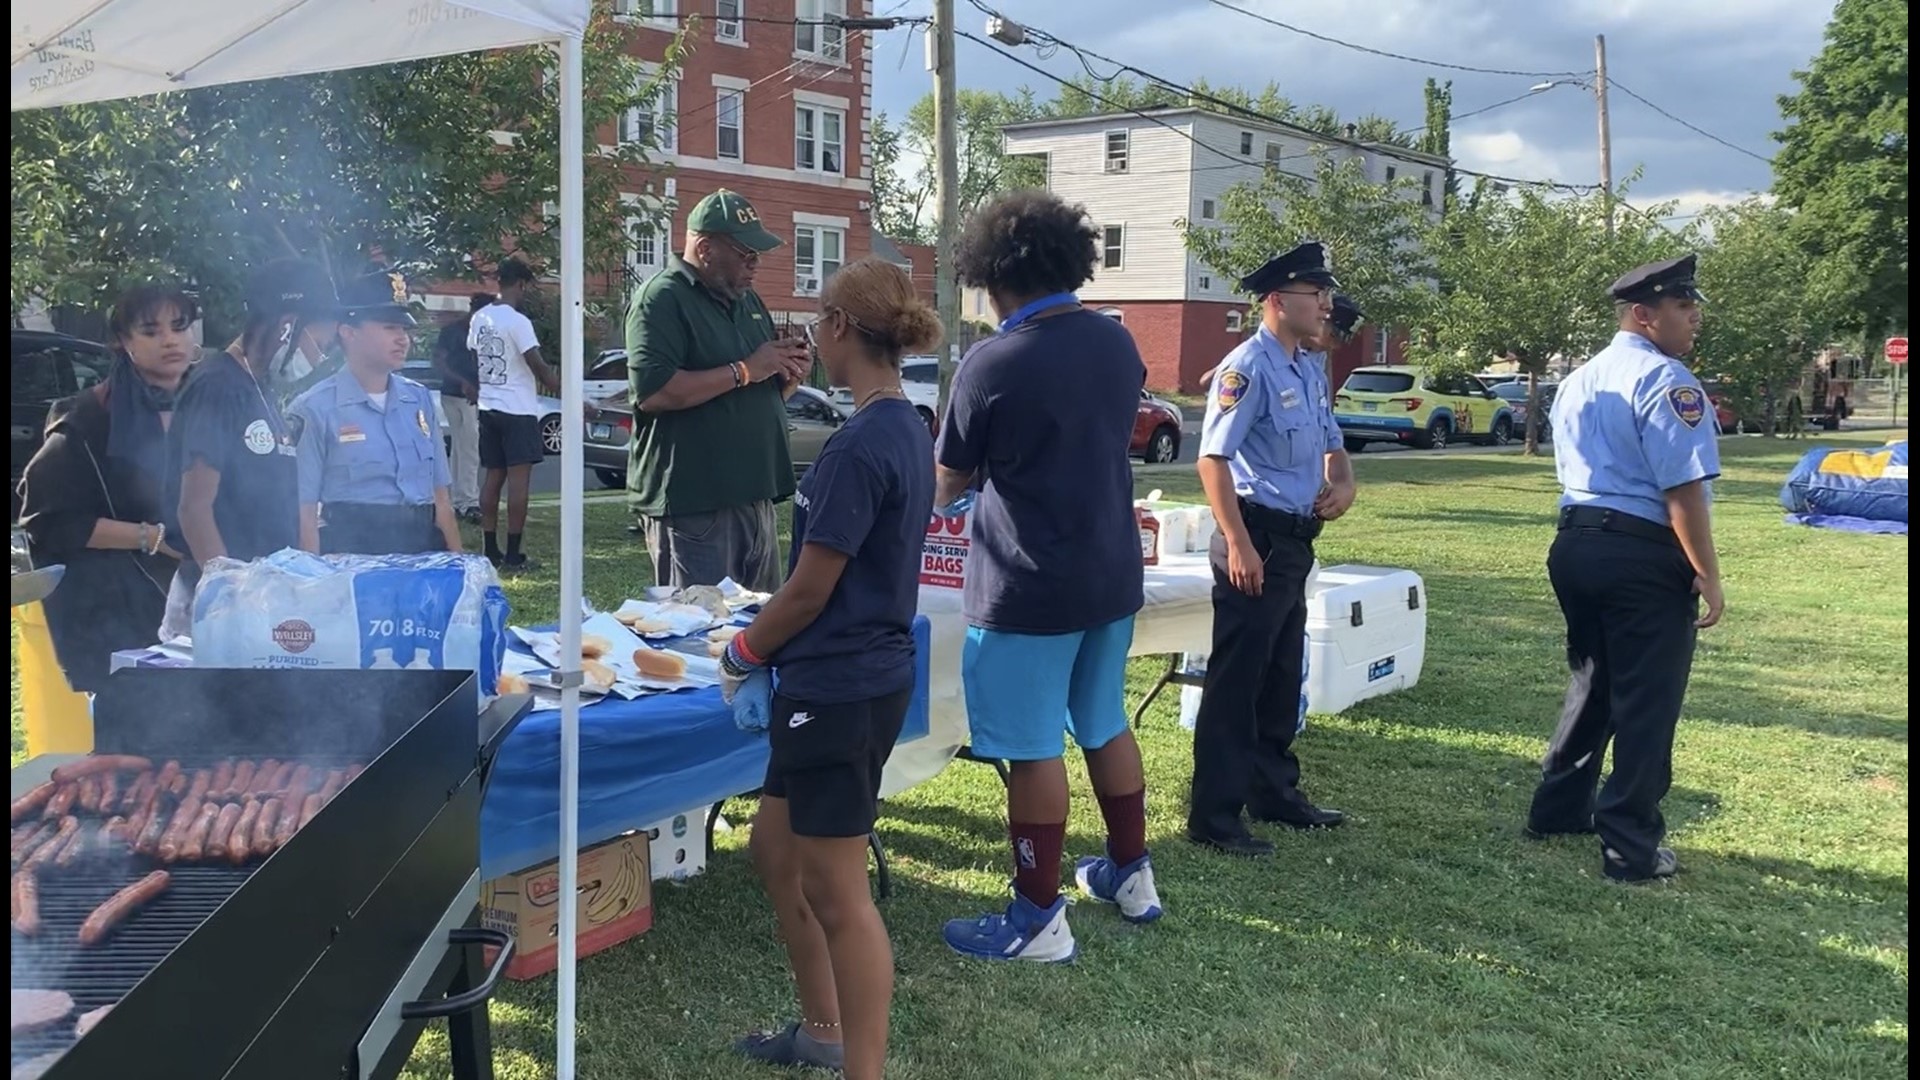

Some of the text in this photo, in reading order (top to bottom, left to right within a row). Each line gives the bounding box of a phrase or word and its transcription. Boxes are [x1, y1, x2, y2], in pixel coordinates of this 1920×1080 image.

[924, 555, 964, 575] BAGS
[368, 619, 394, 637] 70
[402, 618, 414, 636] 8
[268, 655, 320, 667] PURIFIED
[481, 906, 518, 924] REMIUM
[481, 920, 519, 938] ANANAS
